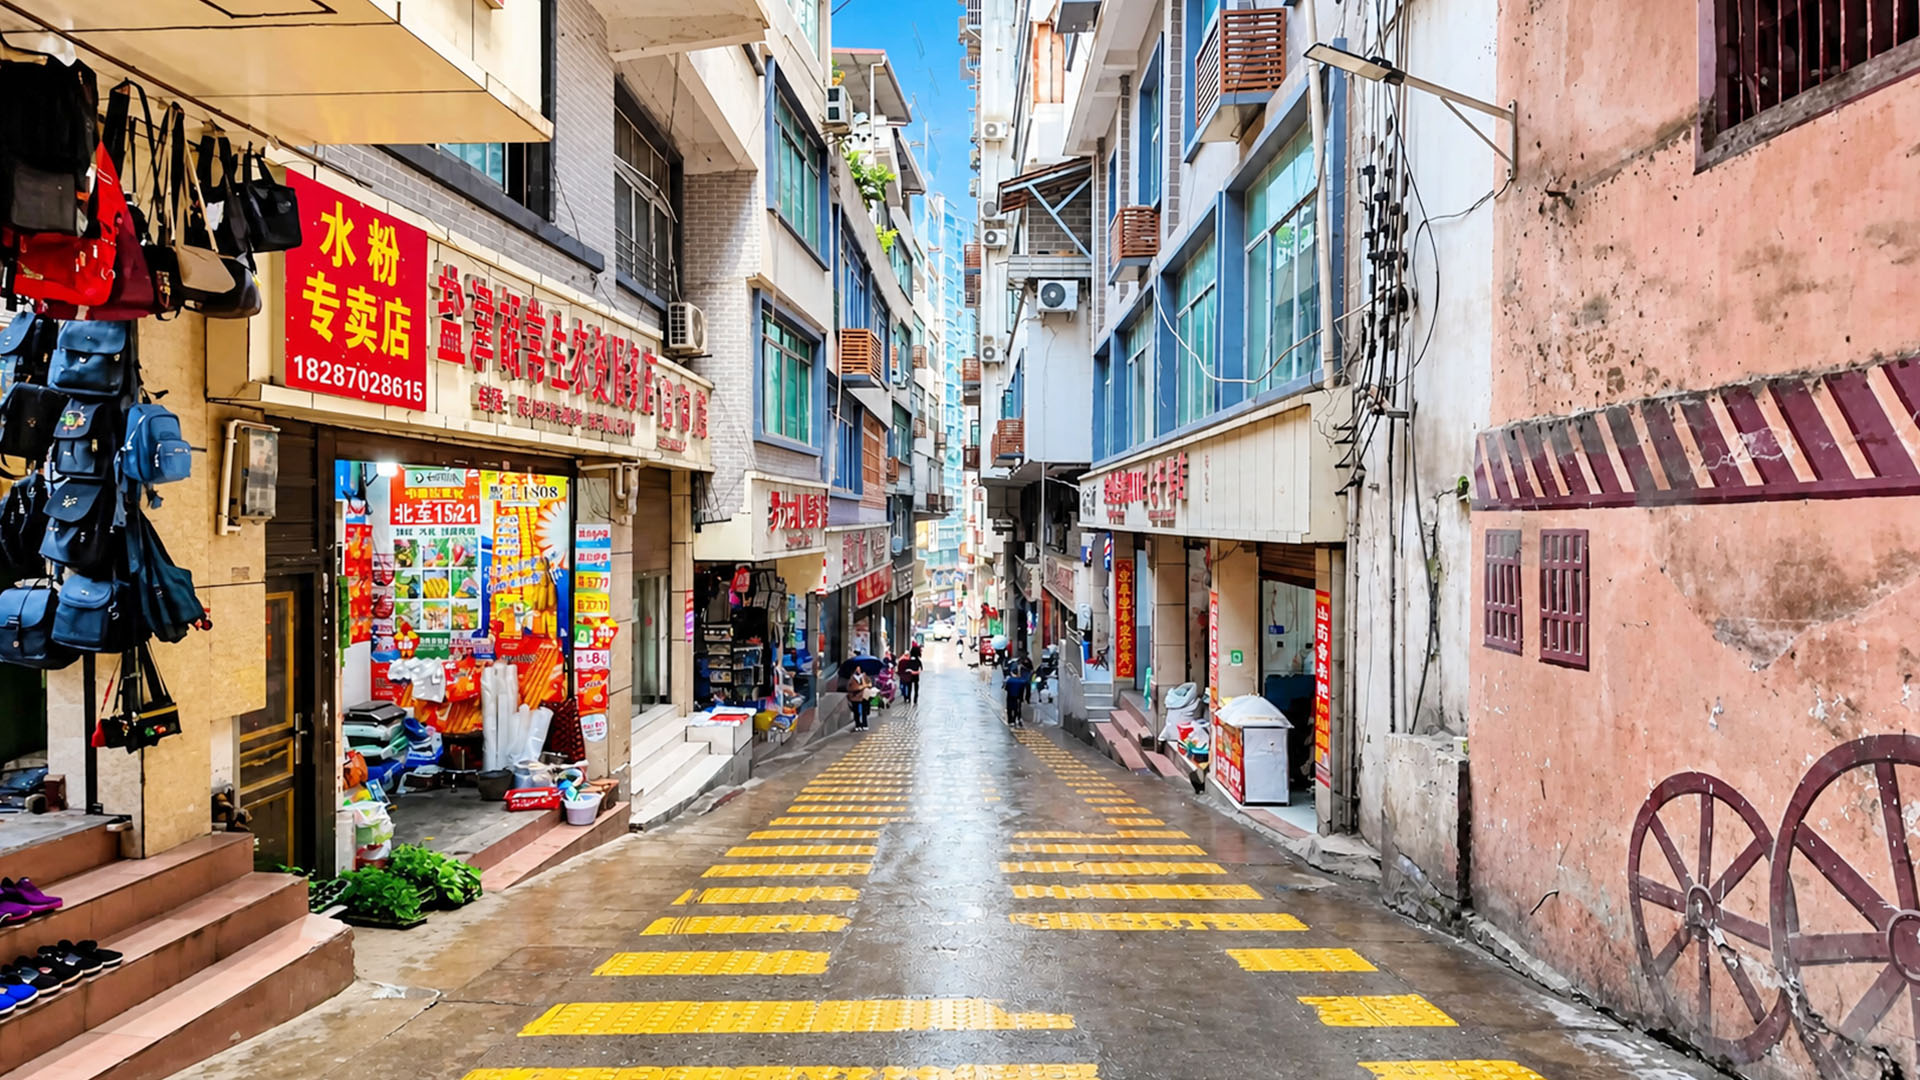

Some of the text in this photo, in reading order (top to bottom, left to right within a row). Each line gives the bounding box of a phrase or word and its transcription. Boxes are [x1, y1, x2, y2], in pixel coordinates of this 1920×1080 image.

[319, 201, 400, 287] 水粉
[302, 271, 412, 360] 专卖店
[294, 355, 423, 402] 18287028615
